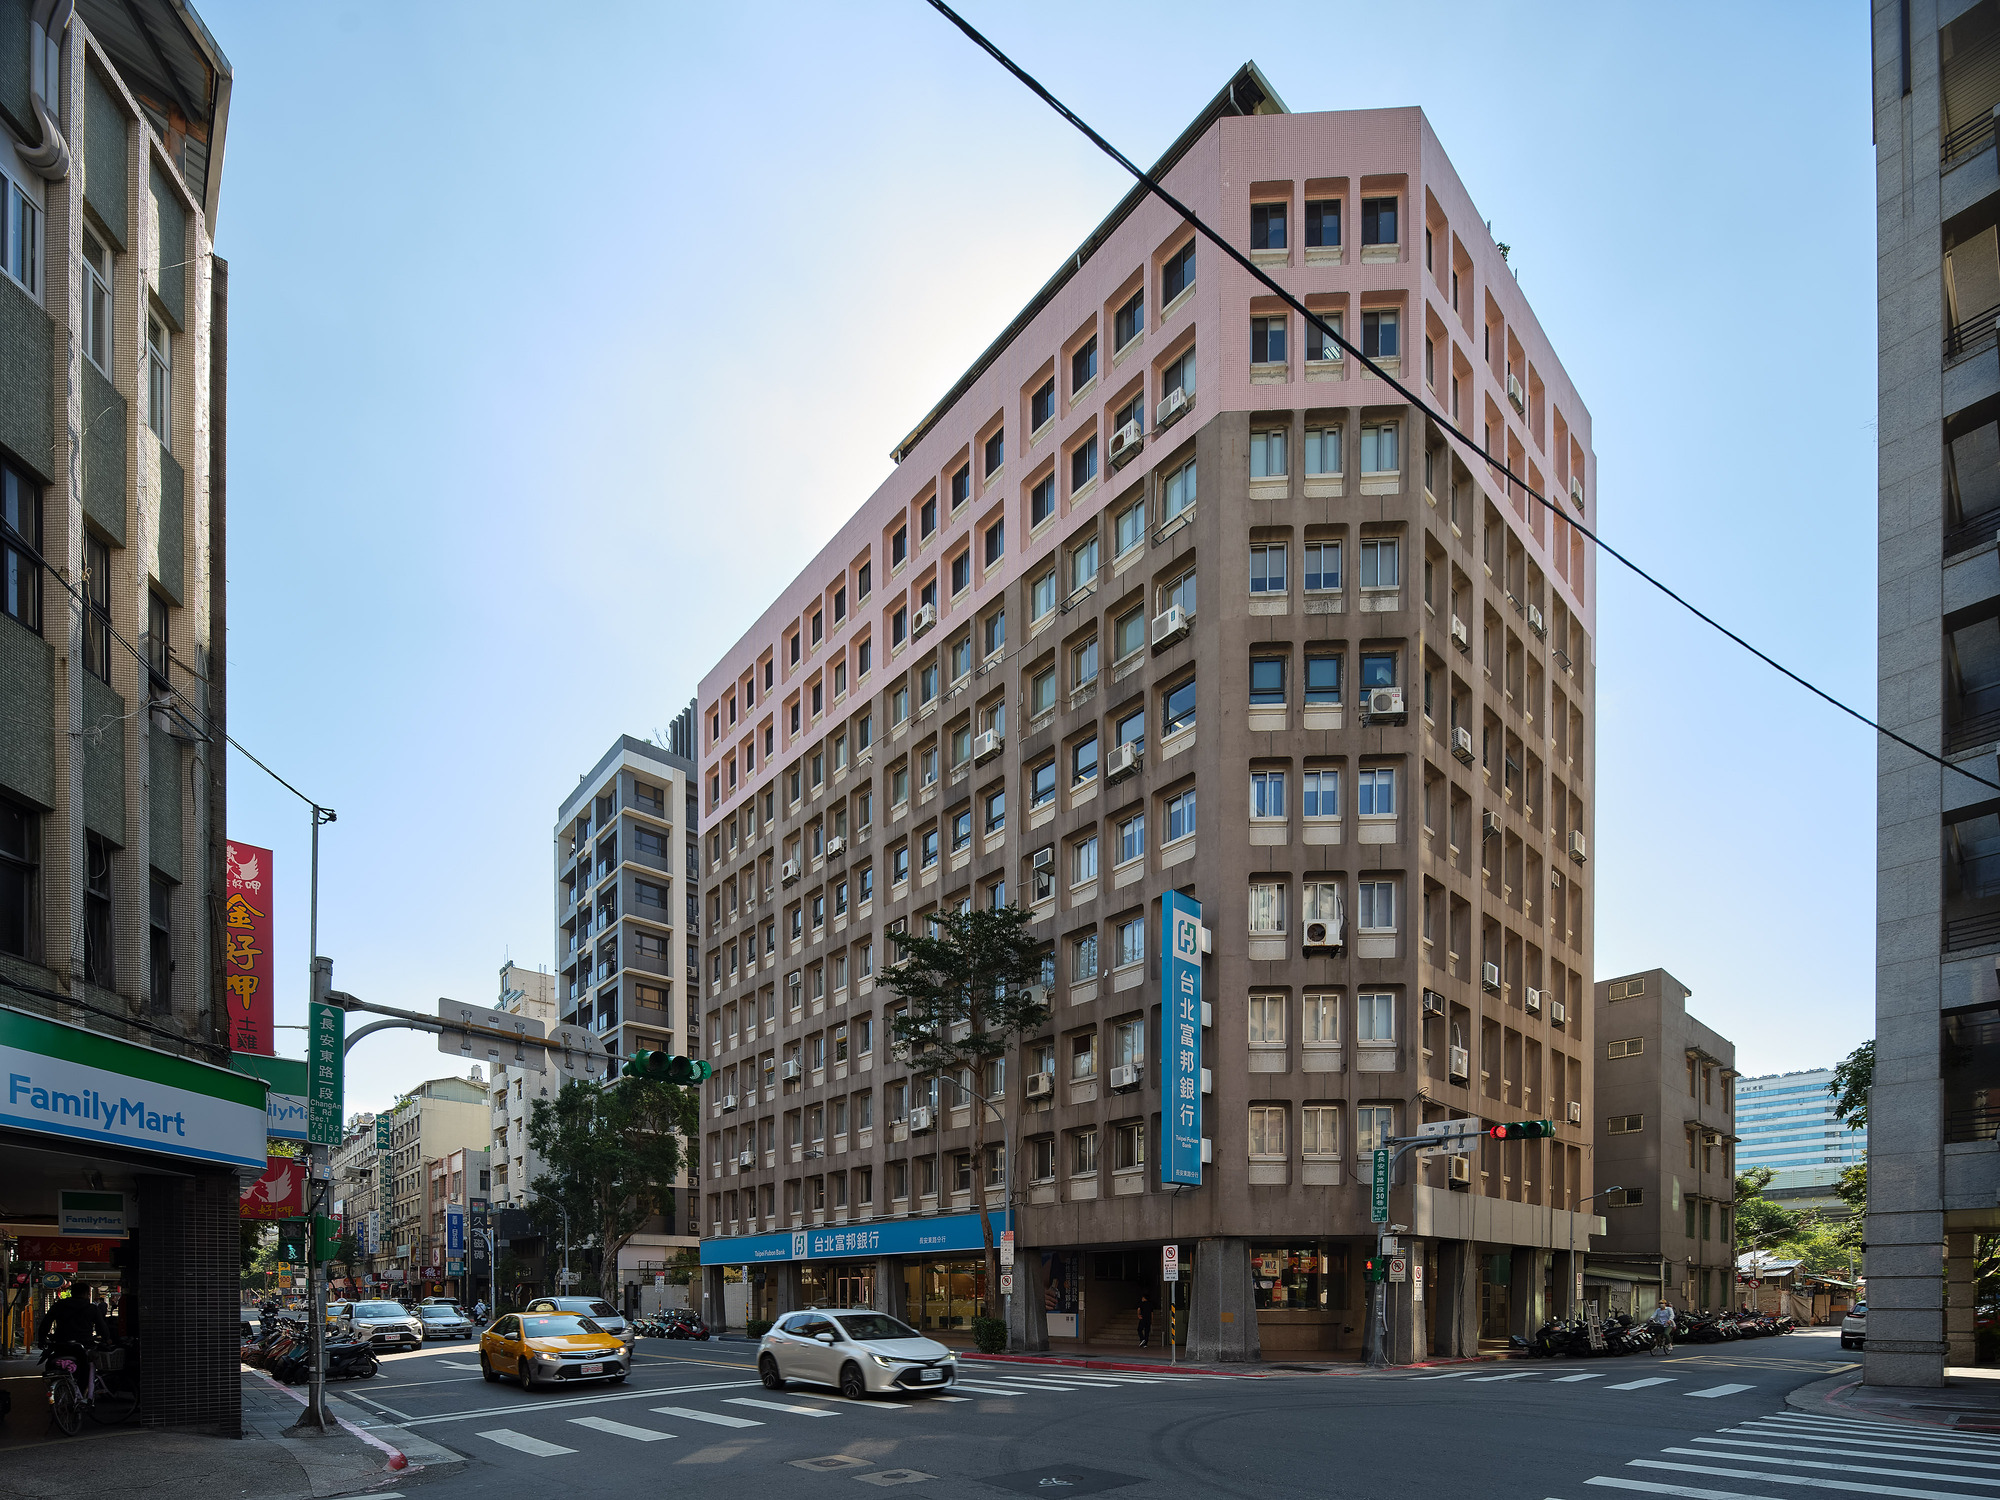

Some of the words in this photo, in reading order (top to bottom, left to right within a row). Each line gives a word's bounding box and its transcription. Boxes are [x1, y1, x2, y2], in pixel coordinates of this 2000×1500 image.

[227, 893, 265, 1010] 金好呷
[237, 1016, 258, 1050] 土雞
[318, 1017, 335, 1100] 長安東路一段
[1180, 970, 1195, 1127] 台北富邦銀行
[9, 1072, 186, 1137] FamilyMart
[310, 1099, 342, 1110] ChangAn
[322, 1108, 334, 1116] Rd.
[65, 1215, 122, 1225] FamilyMart
[240, 1203, 294, 1217] 金好呷
[814, 1231, 880, 1253] 台北富邦銀行
